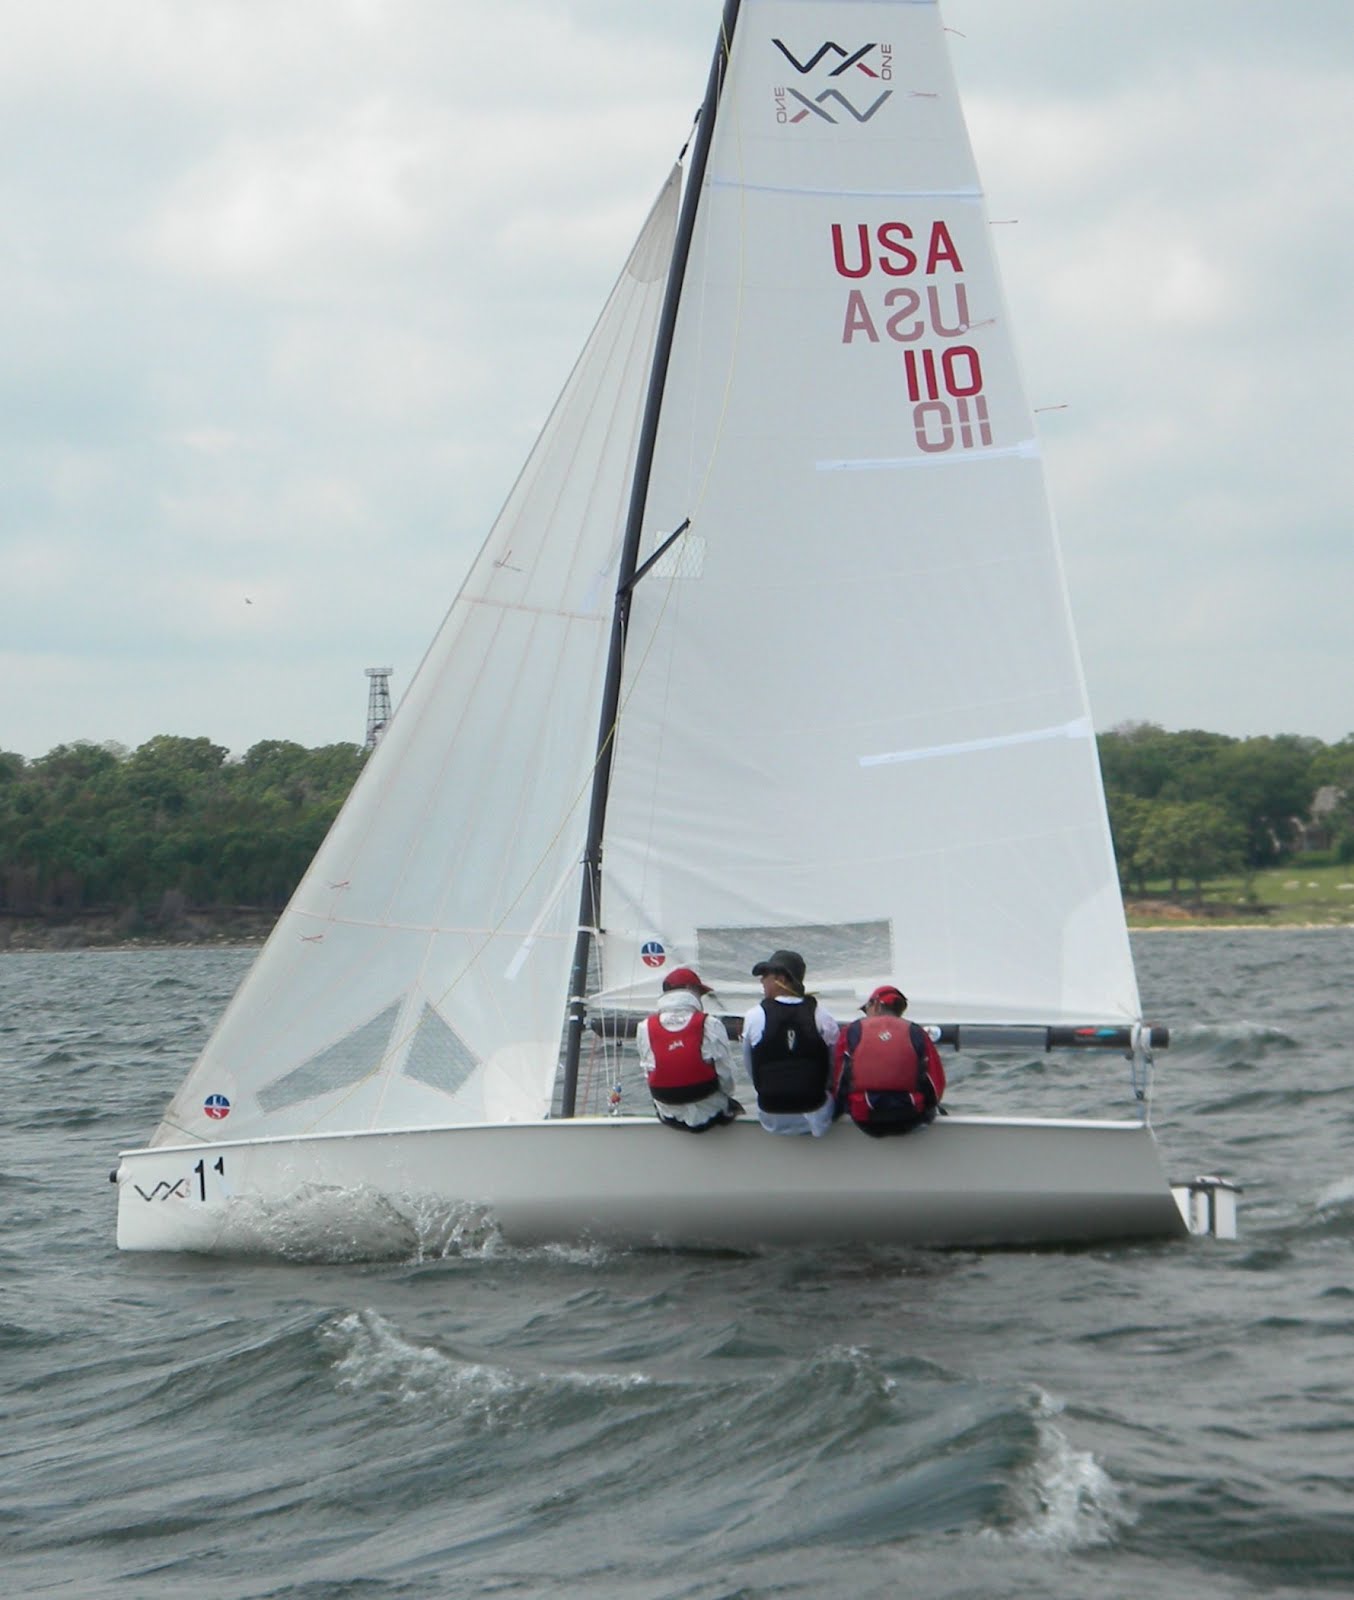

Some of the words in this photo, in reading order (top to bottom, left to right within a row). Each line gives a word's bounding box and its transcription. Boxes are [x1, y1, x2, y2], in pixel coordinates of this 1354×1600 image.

[881, 43, 893, 80] ONE
[831, 221, 964, 278] USA
[904, 345, 983, 402] 110
